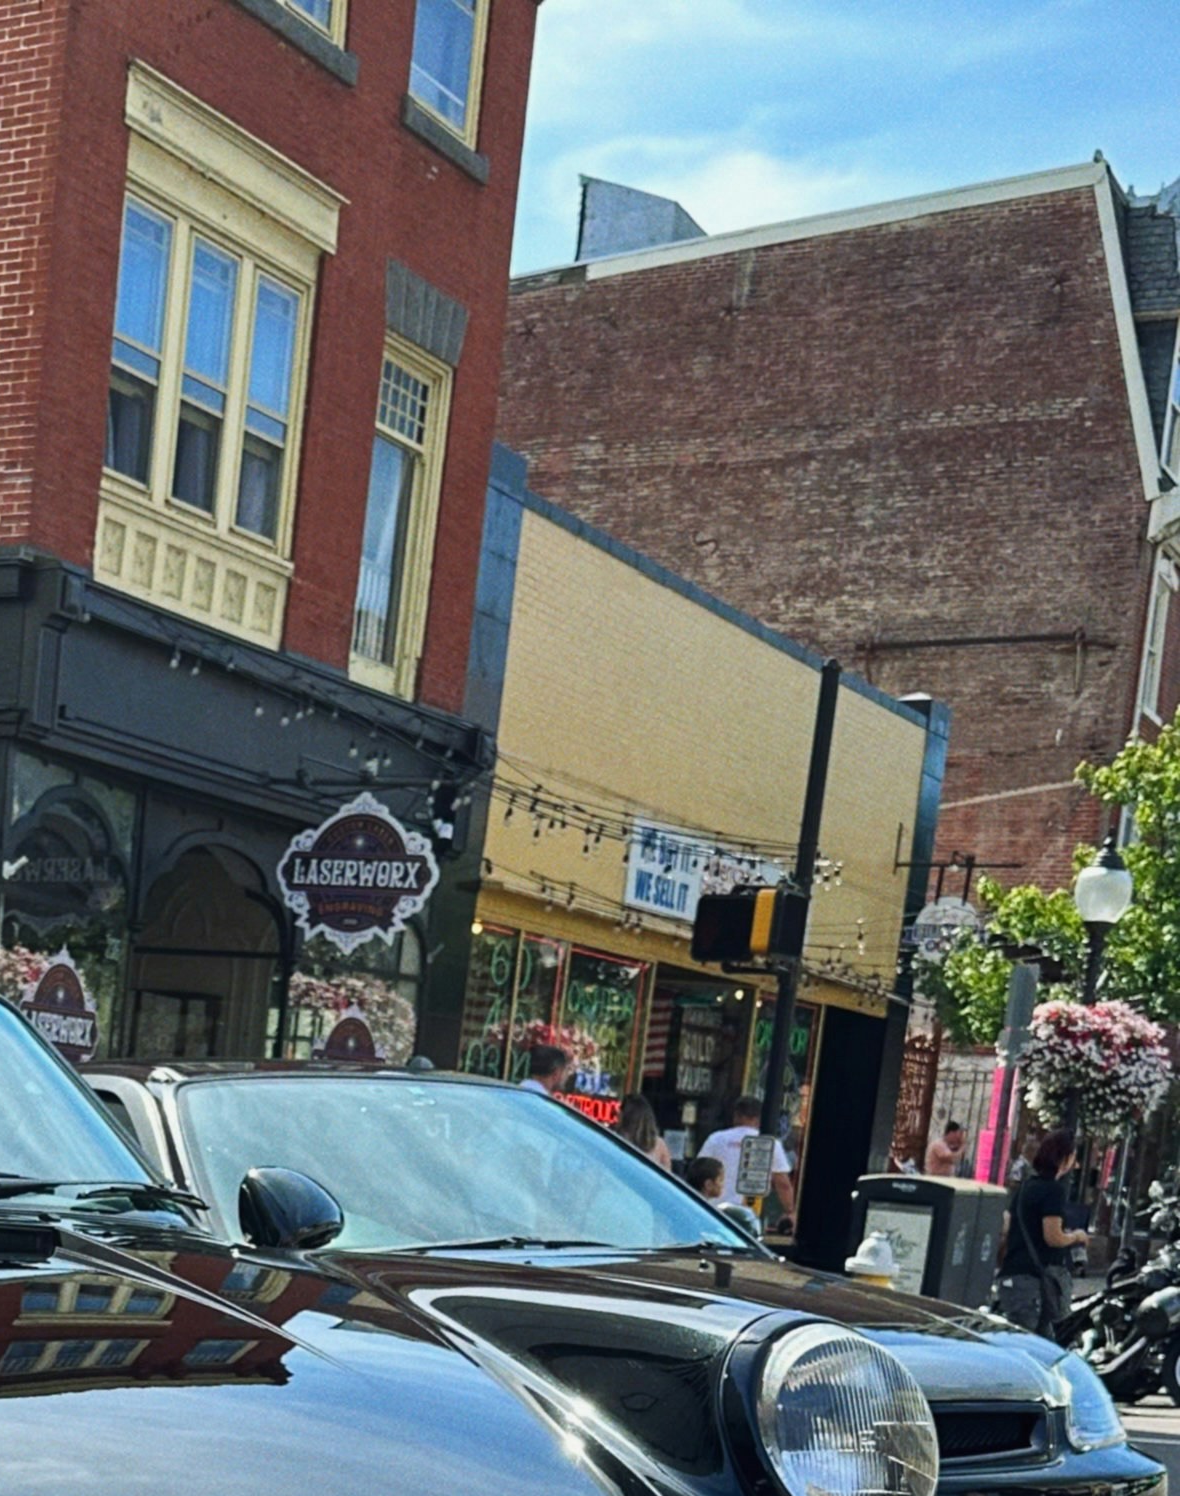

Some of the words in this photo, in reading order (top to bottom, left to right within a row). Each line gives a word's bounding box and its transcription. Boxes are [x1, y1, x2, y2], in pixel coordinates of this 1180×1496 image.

[292, 857, 421, 890] LASERWORX
[635, 869, 654, 902] WE
[653, 876, 677, 911] SELL
[676, 882, 690, 914] IT
